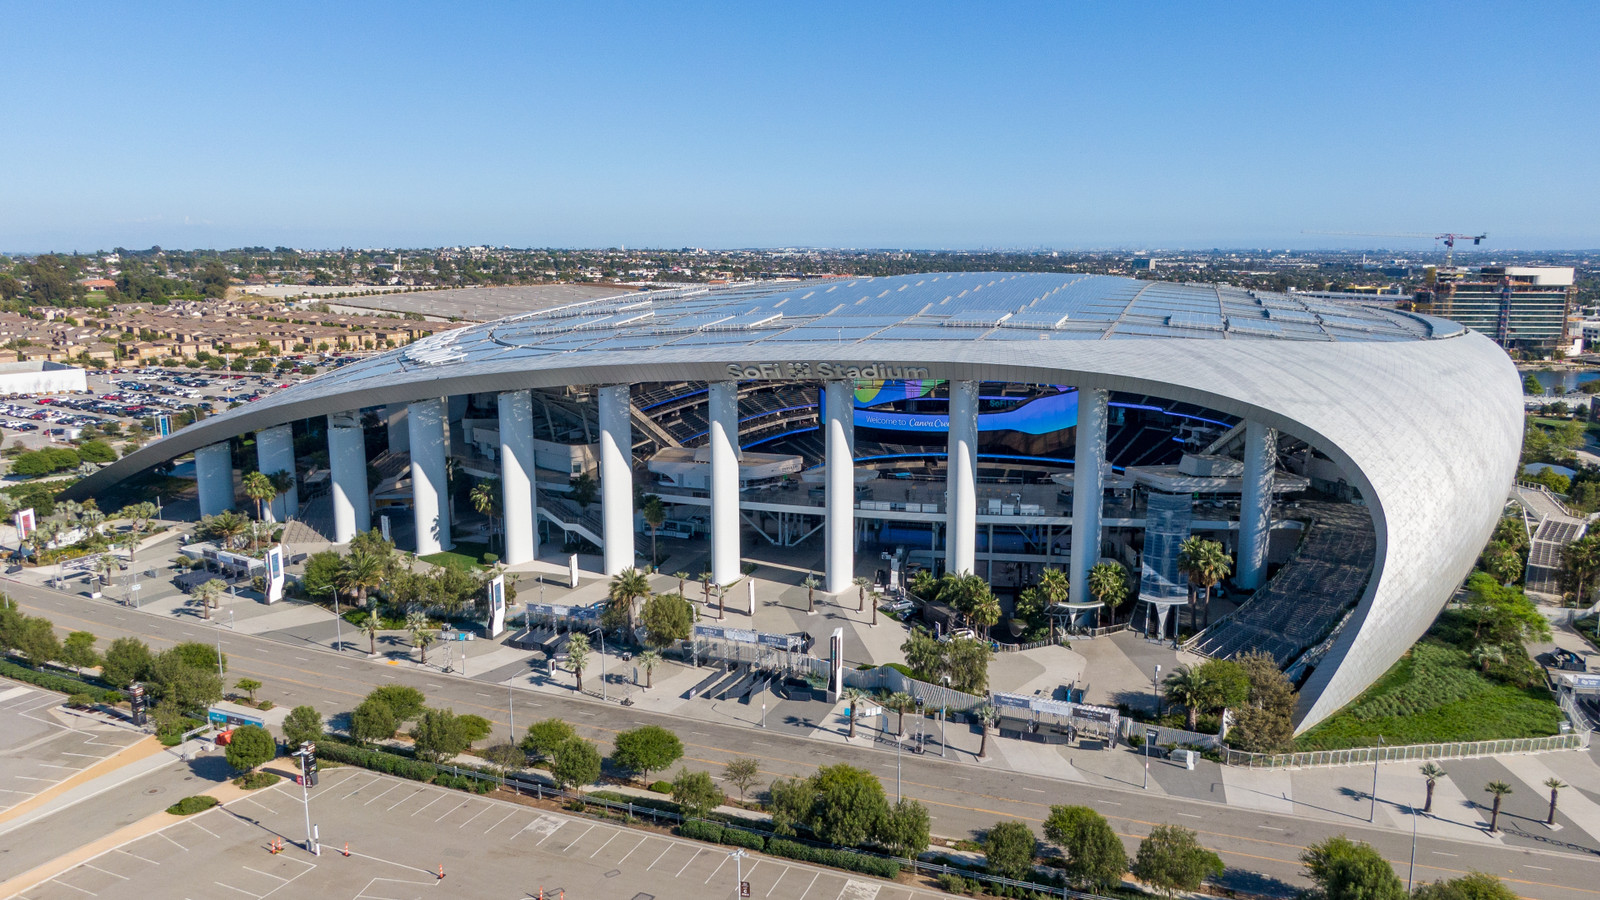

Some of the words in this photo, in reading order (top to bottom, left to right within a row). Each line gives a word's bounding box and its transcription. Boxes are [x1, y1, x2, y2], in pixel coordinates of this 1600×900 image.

[726, 363, 783, 379] SoFi
[817, 362, 929, 379] Stadium
[866, 415, 898, 425] Welcome
[909, 418, 934, 427] Canva
